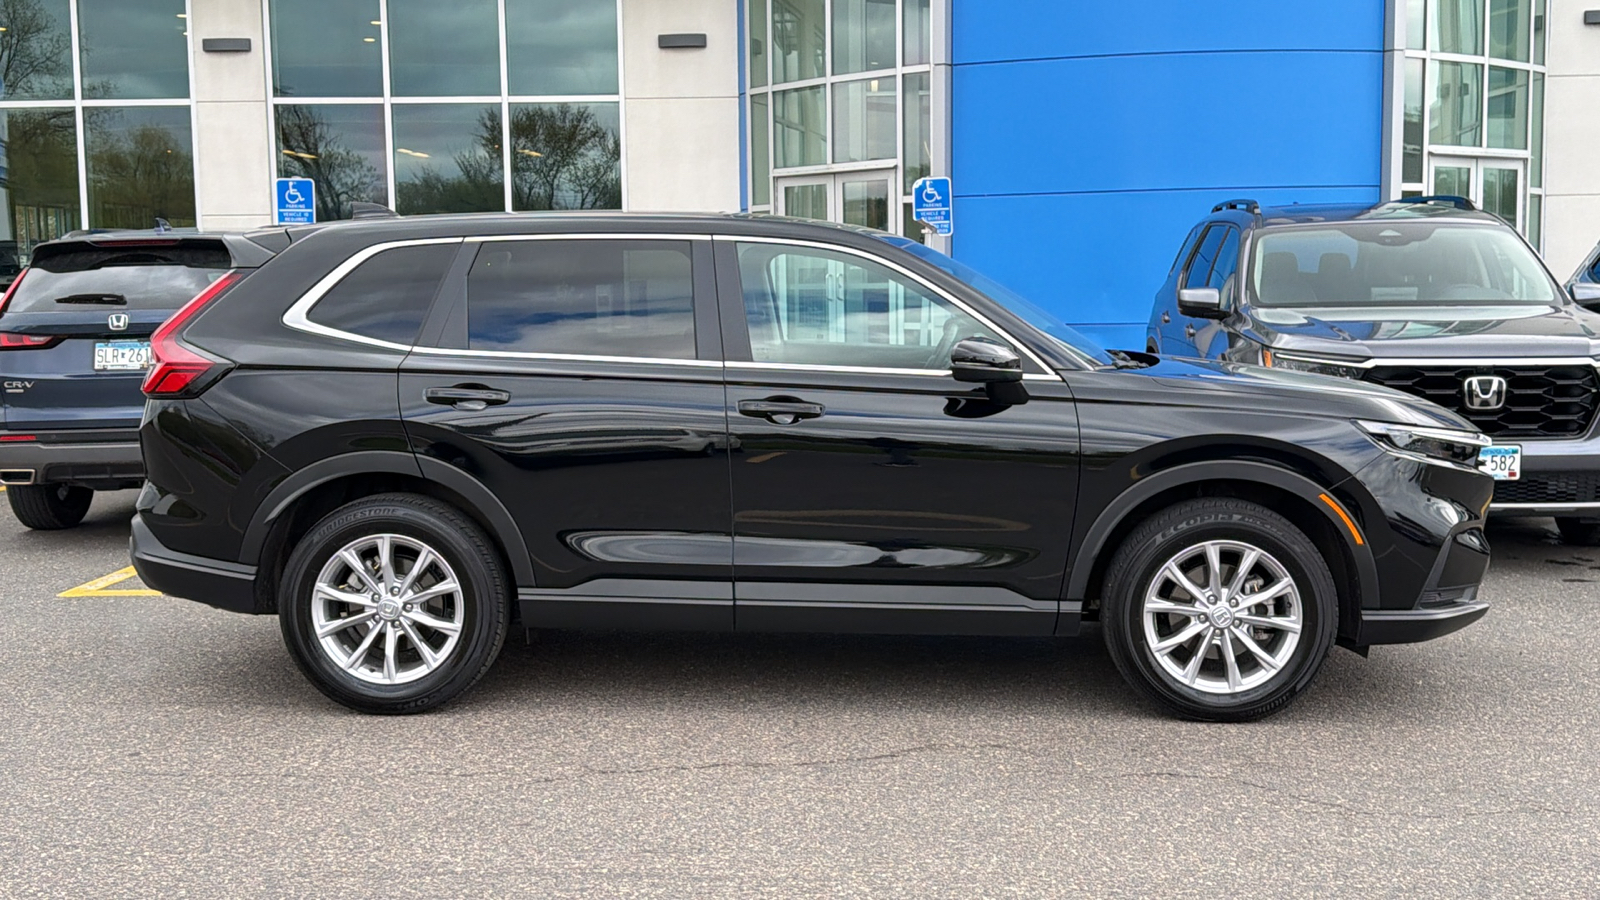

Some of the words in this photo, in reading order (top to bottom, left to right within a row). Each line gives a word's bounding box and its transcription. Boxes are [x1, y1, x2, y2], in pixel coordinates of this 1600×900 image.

[97, 348, 119, 363] SLR
[128, 347, 150, 363] 261
[1491, 455, 1516, 471] 582
[318, 507, 399, 538] BRIDGESTONE
